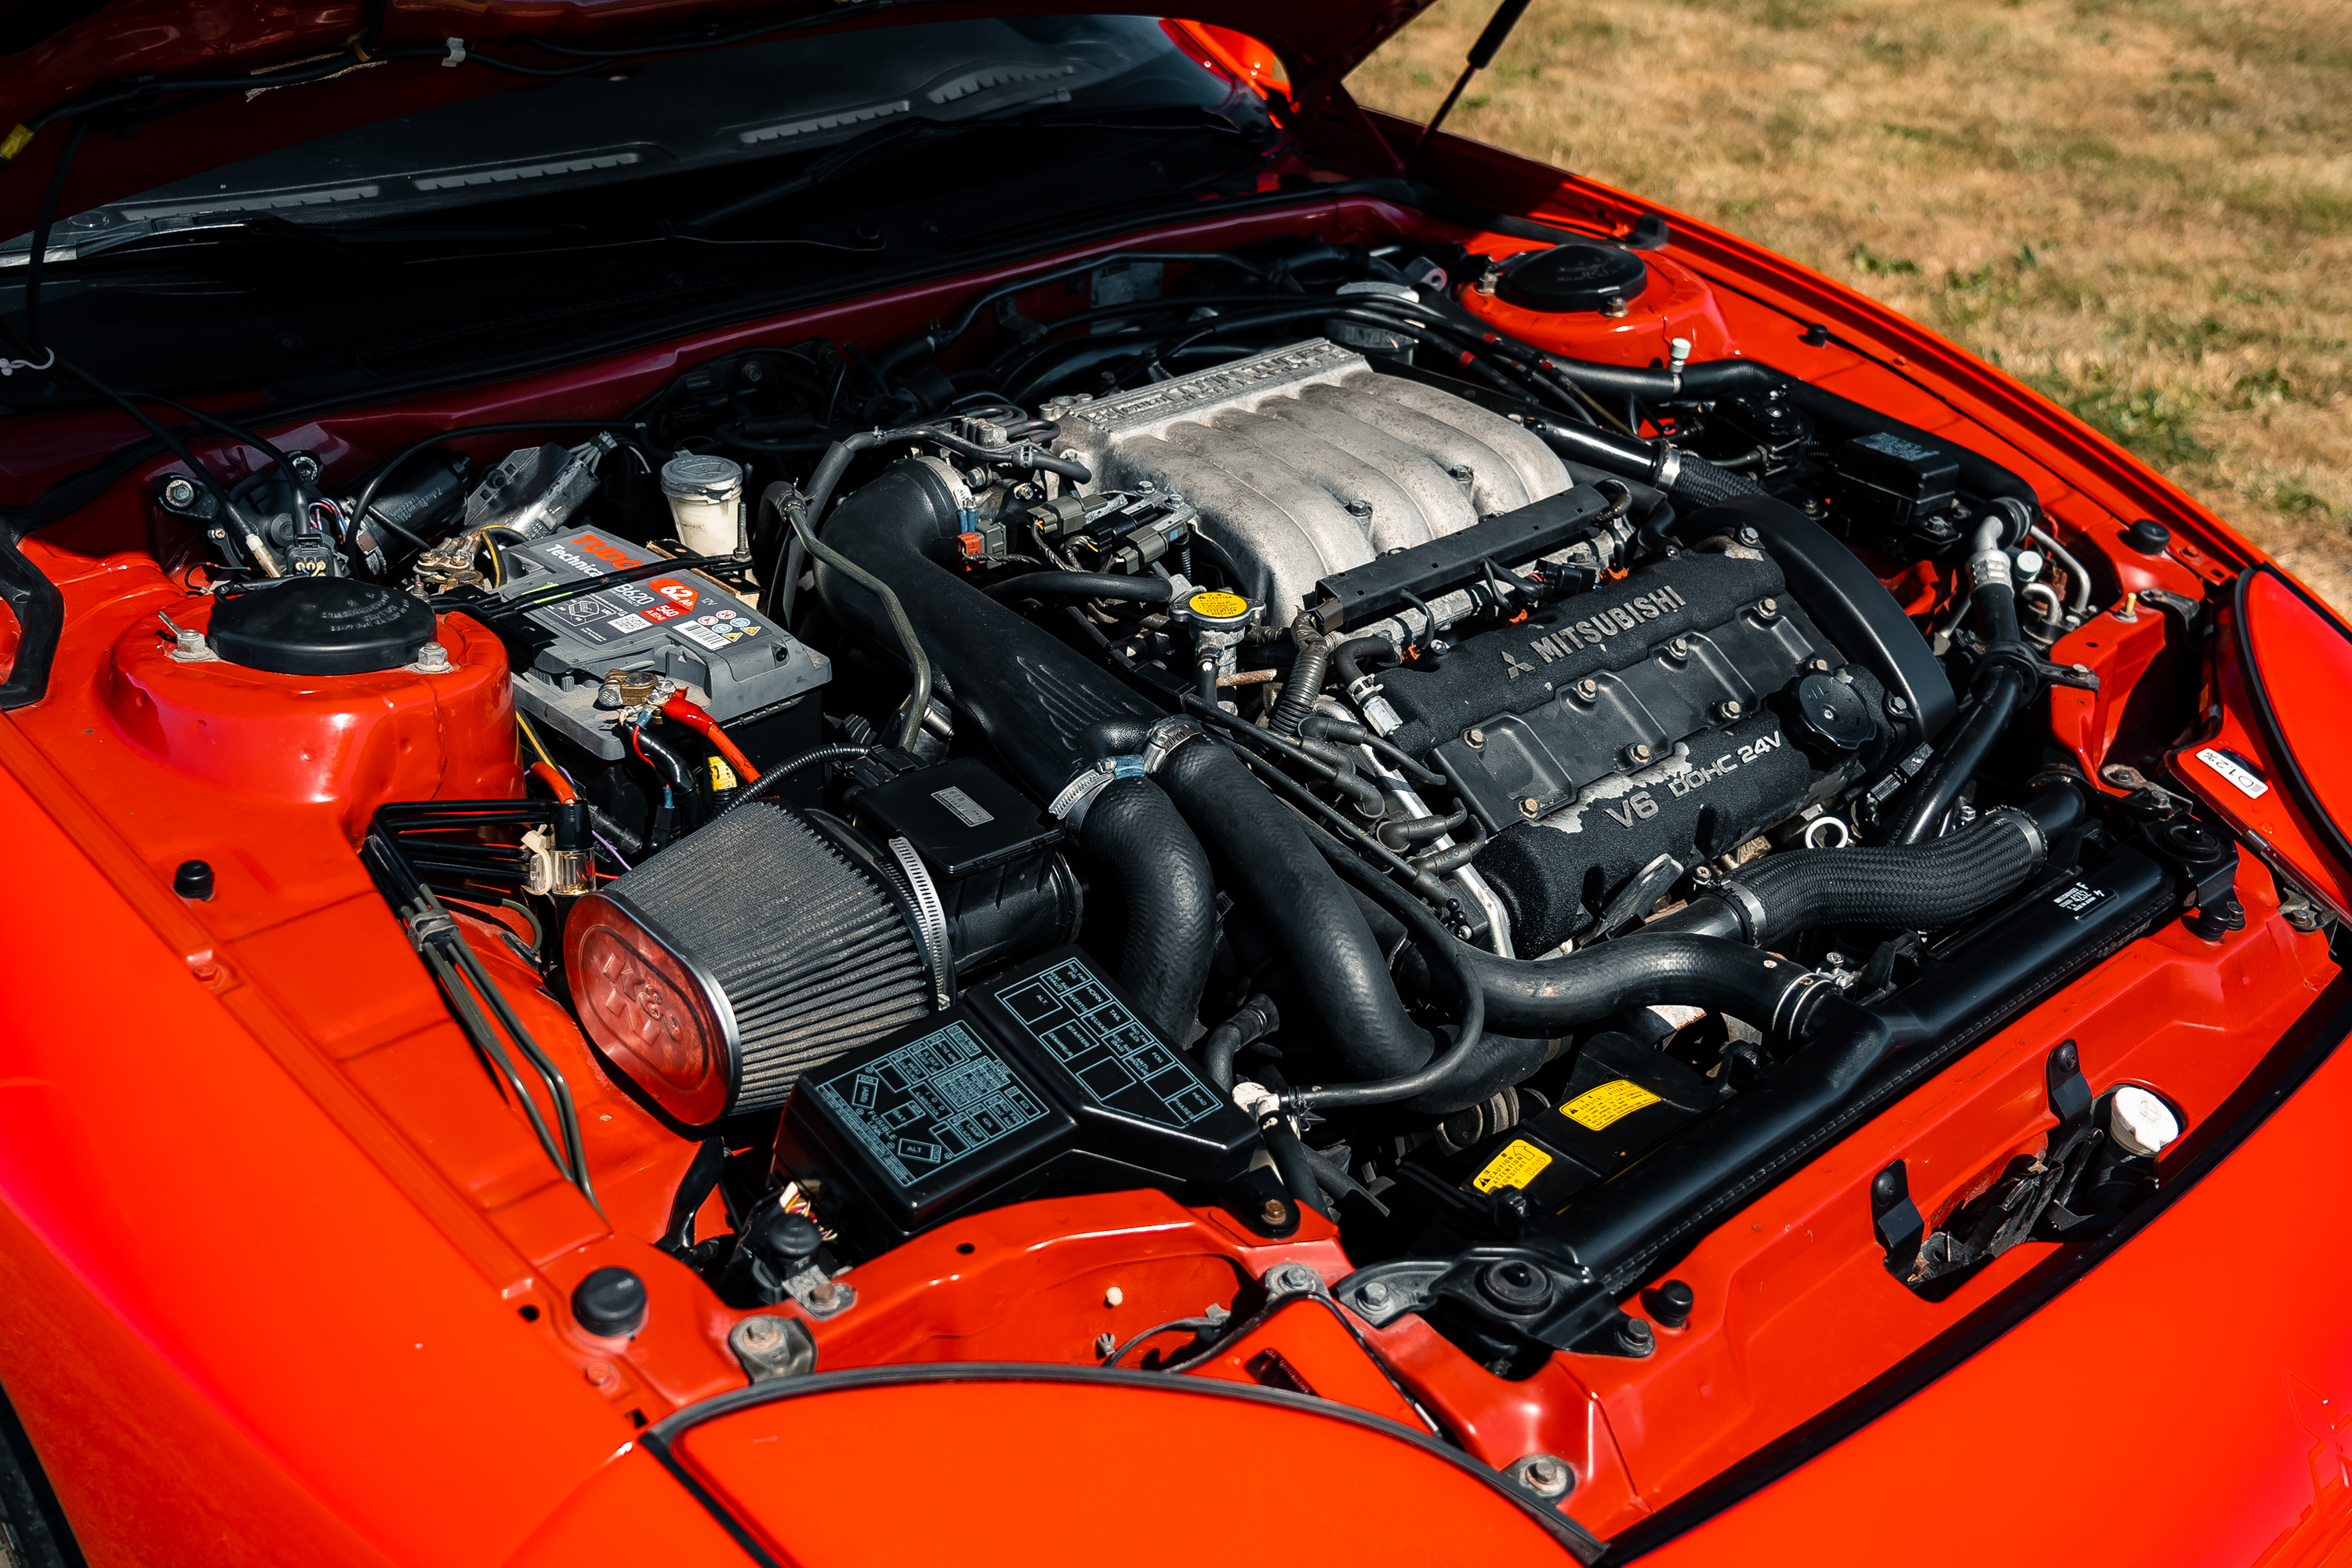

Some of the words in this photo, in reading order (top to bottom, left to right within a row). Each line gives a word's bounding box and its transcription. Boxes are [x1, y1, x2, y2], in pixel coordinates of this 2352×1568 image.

[571, 535, 643, 570] TUDO
[660, 586, 693, 600] 62
[679, 598, 693, 607] Ah
[656, 604, 680, 617] 540
[1530, 586, 1686, 664] MITSUBISHI
[2202, 752, 2237, 776] 1.2%
[1604, 790, 1659, 829] V6
[1667, 754, 1739, 799] DOHC
[1737, 730, 1782, 765] 24V
[602, 952, 684, 1047] K&N
[1035, 993, 1049, 1005] ALT.
[1084, 985, 1104, 1003] HORN
[1107, 1008, 1123, 1022] TAIL
[1065, 1024, 1091, 1047] (STARTER)
[1150, 1051, 1164, 1063] FOG
[992, 1058, 1011, 1076] FUSE
[860, 1086, 869, 1103] (ABS)
[1191, 1091, 1207, 1105] HEAD
[1018, 1099, 1030, 1109] ECI
[866, 1109, 898, 1140] FUSIBLE
[866, 1120, 884, 1136] LINK
[965, 1123, 982, 1138] LAMP
[1489, 1156, 1513, 1178] CAUTION
[1493, 1156, 1523, 1184] ATTENTION
